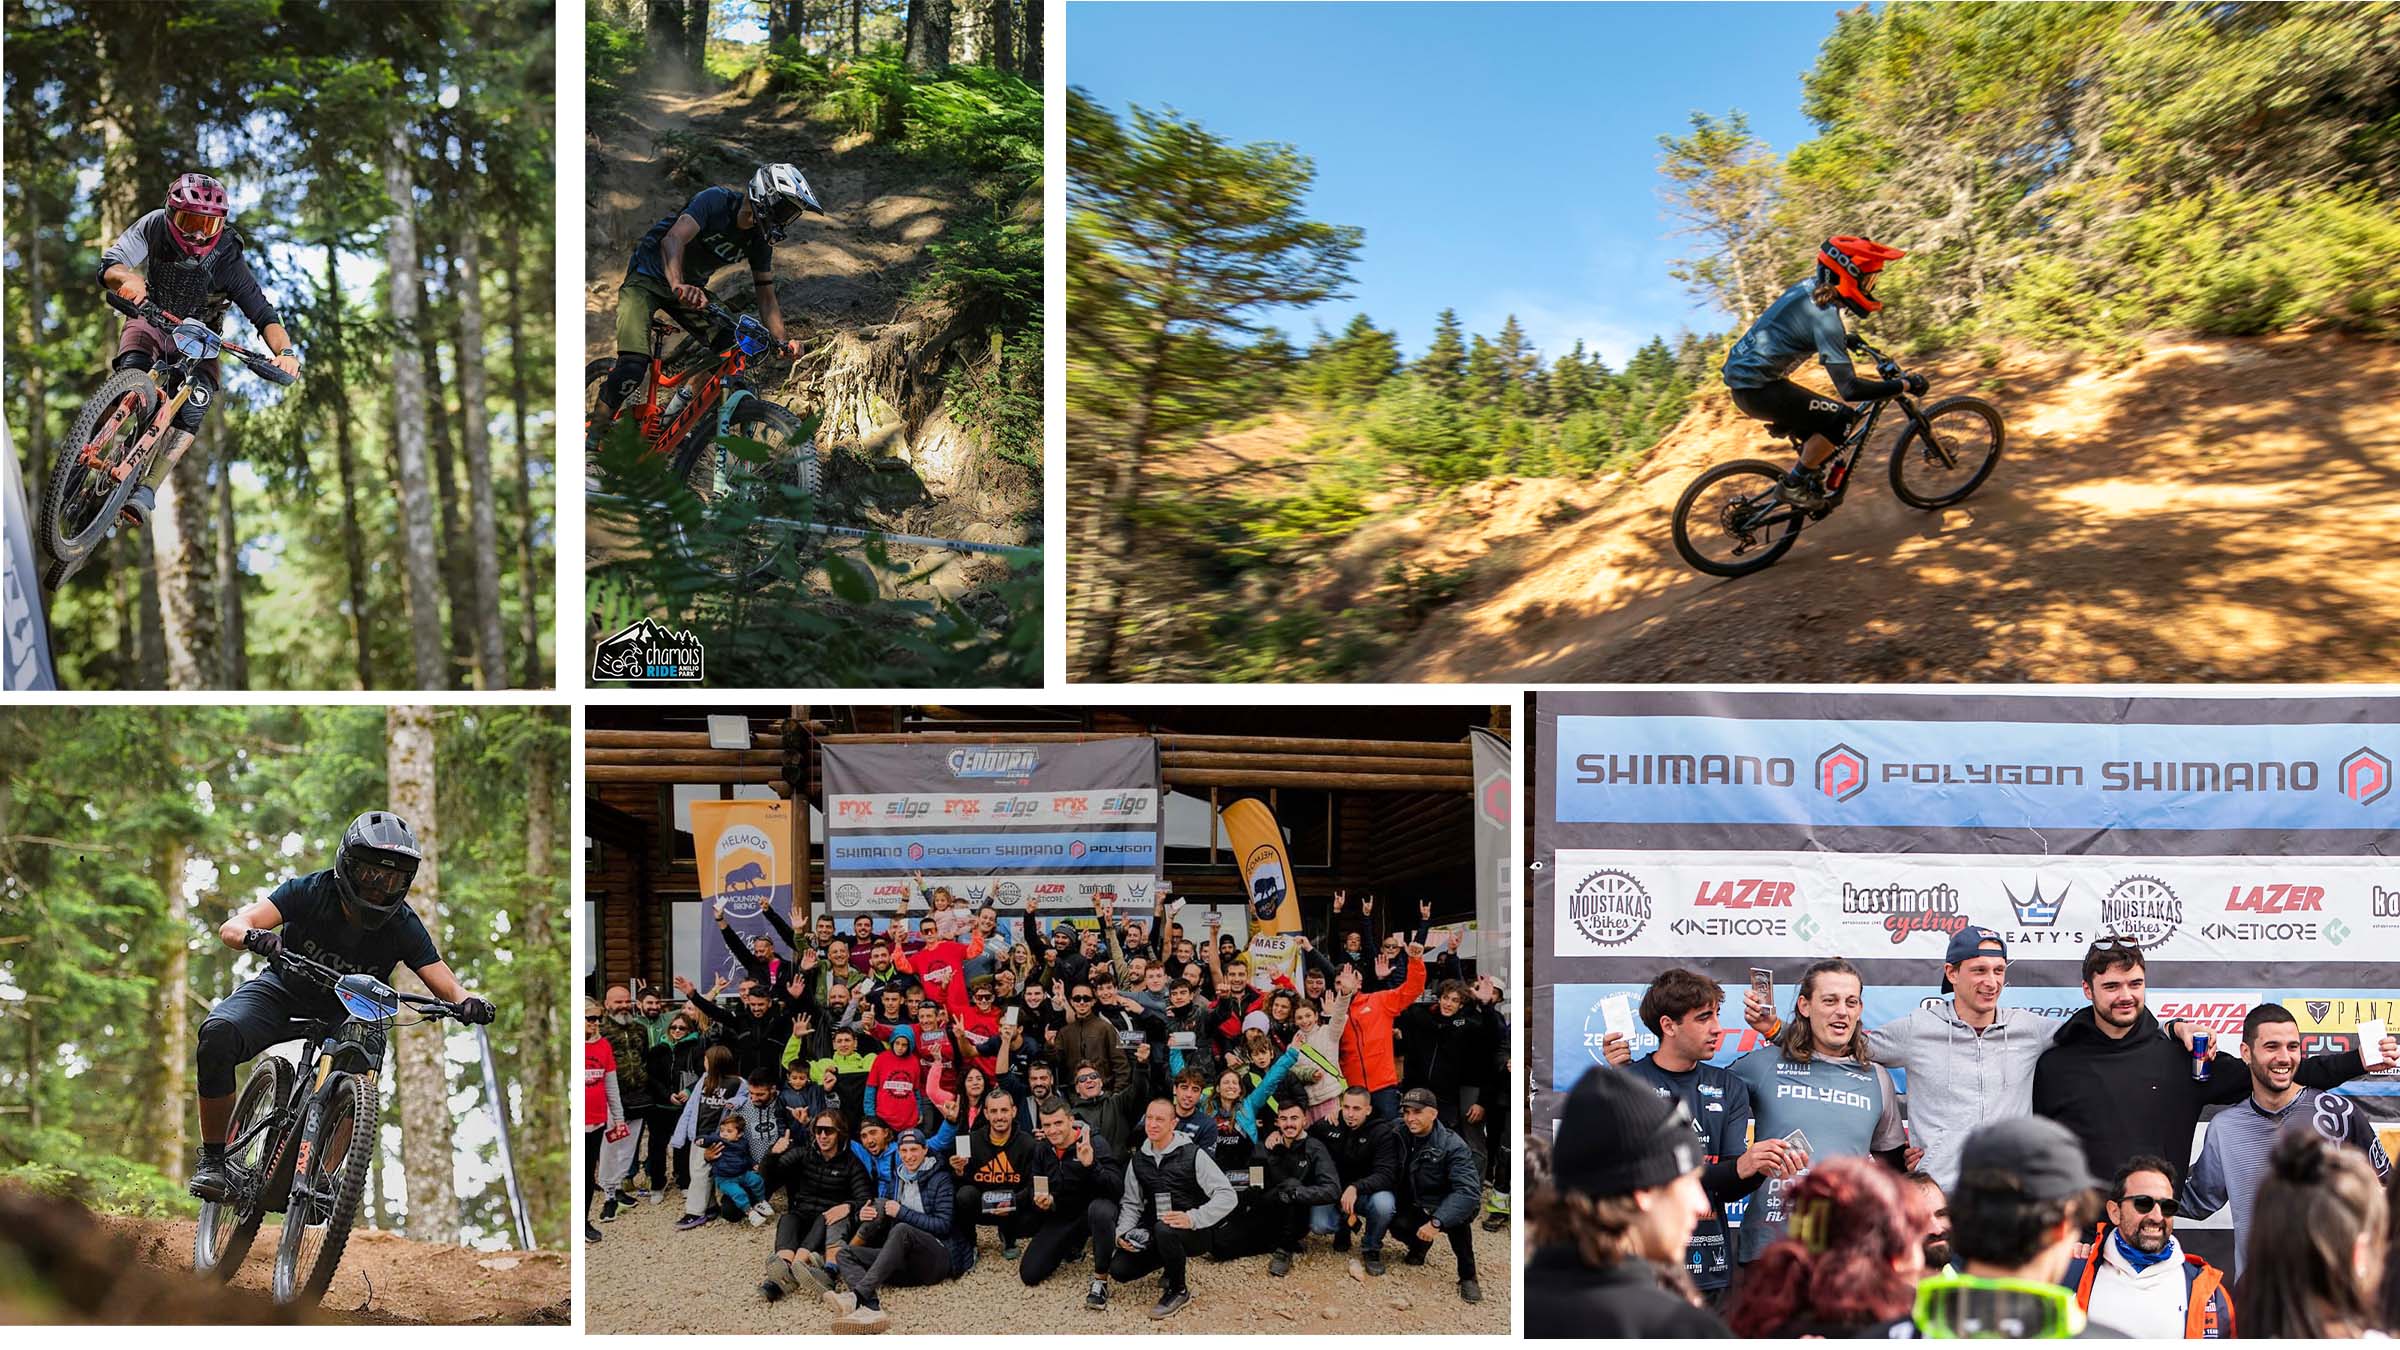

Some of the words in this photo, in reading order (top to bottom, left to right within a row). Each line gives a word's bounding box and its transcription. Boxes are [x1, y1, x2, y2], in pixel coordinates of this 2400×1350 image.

[1576, 753, 1795, 787] SHIMANO
[1881, 763, 2083, 786] POLYGON
[2102, 761, 2318, 792] SHIMANO
[838, 799, 873, 816] FOX
[721, 833, 768, 850] HELMOS
[836, 847, 903, 858] SHIMANO
[928, 847, 991, 855] POLYGON
[995, 845, 1064, 856] SHIMANO
[1090, 845, 1153, 853] POLYGON
[1034, 883, 1066, 894] LAZER
[1693, 879, 1796, 909] LAZER
[1842, 882, 1959, 914] kassimatis
[2224, 884, 2325, 914] LAZER
[1569, 894, 1652, 920] MOUSTAKAS
[2101, 899, 2183, 925] MOUSTAKAS
[1591, 914, 1629, 930] Bikes
[1670, 918, 1787, 936] KINETICORE
[1884, 908, 1970, 945] cycling
[2121, 920, 2163, 934] Bikes
[2005, 931, 2084, 943] EATY'S
[2201, 923, 2317, 941] KINETICORE
[1255, 938, 1287, 950] MAES
[2157, 1003, 2247, 1018] SANTA
[1777, 1084, 1871, 1112] POLYGON
[973, 1172, 1021, 1184] adidas
